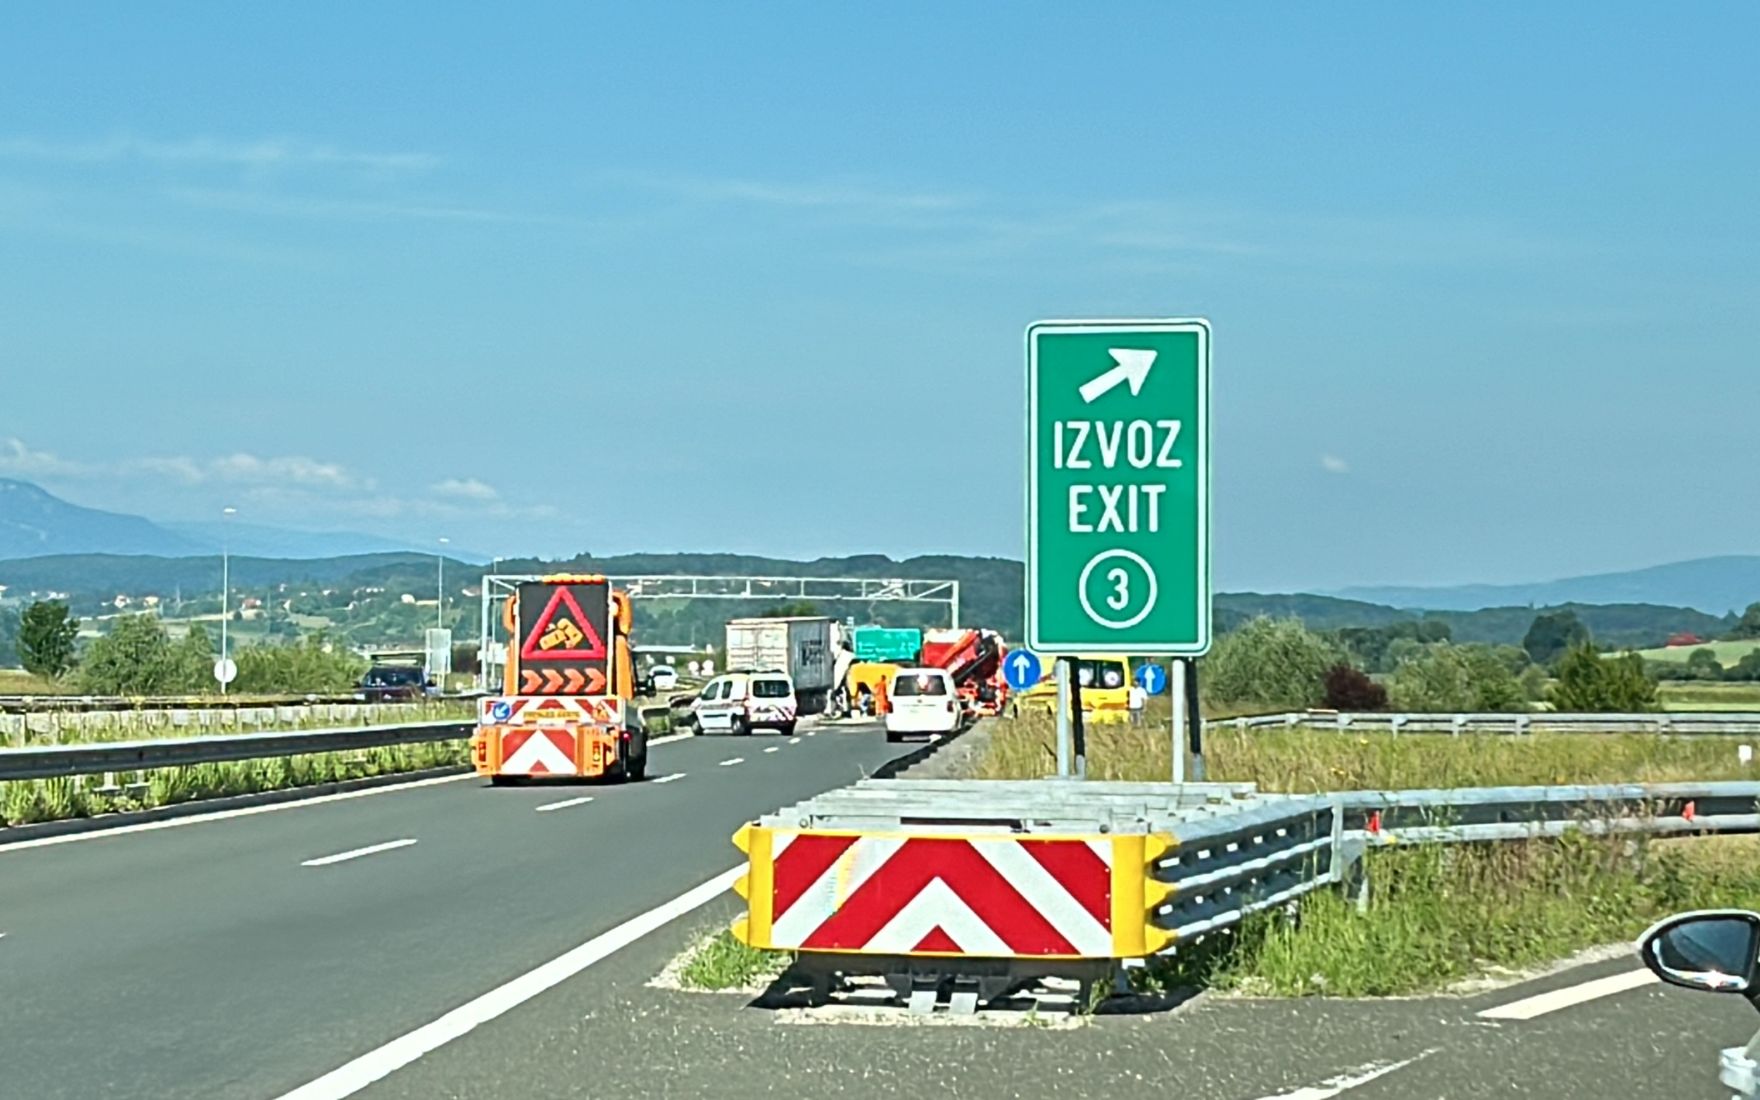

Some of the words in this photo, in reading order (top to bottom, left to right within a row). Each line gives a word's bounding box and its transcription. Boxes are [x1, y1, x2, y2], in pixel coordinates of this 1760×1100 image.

[1054, 420, 1182, 469] IZVOZ
[1069, 485, 1166, 533] EXIT
[1106, 568, 1129, 610] 3
